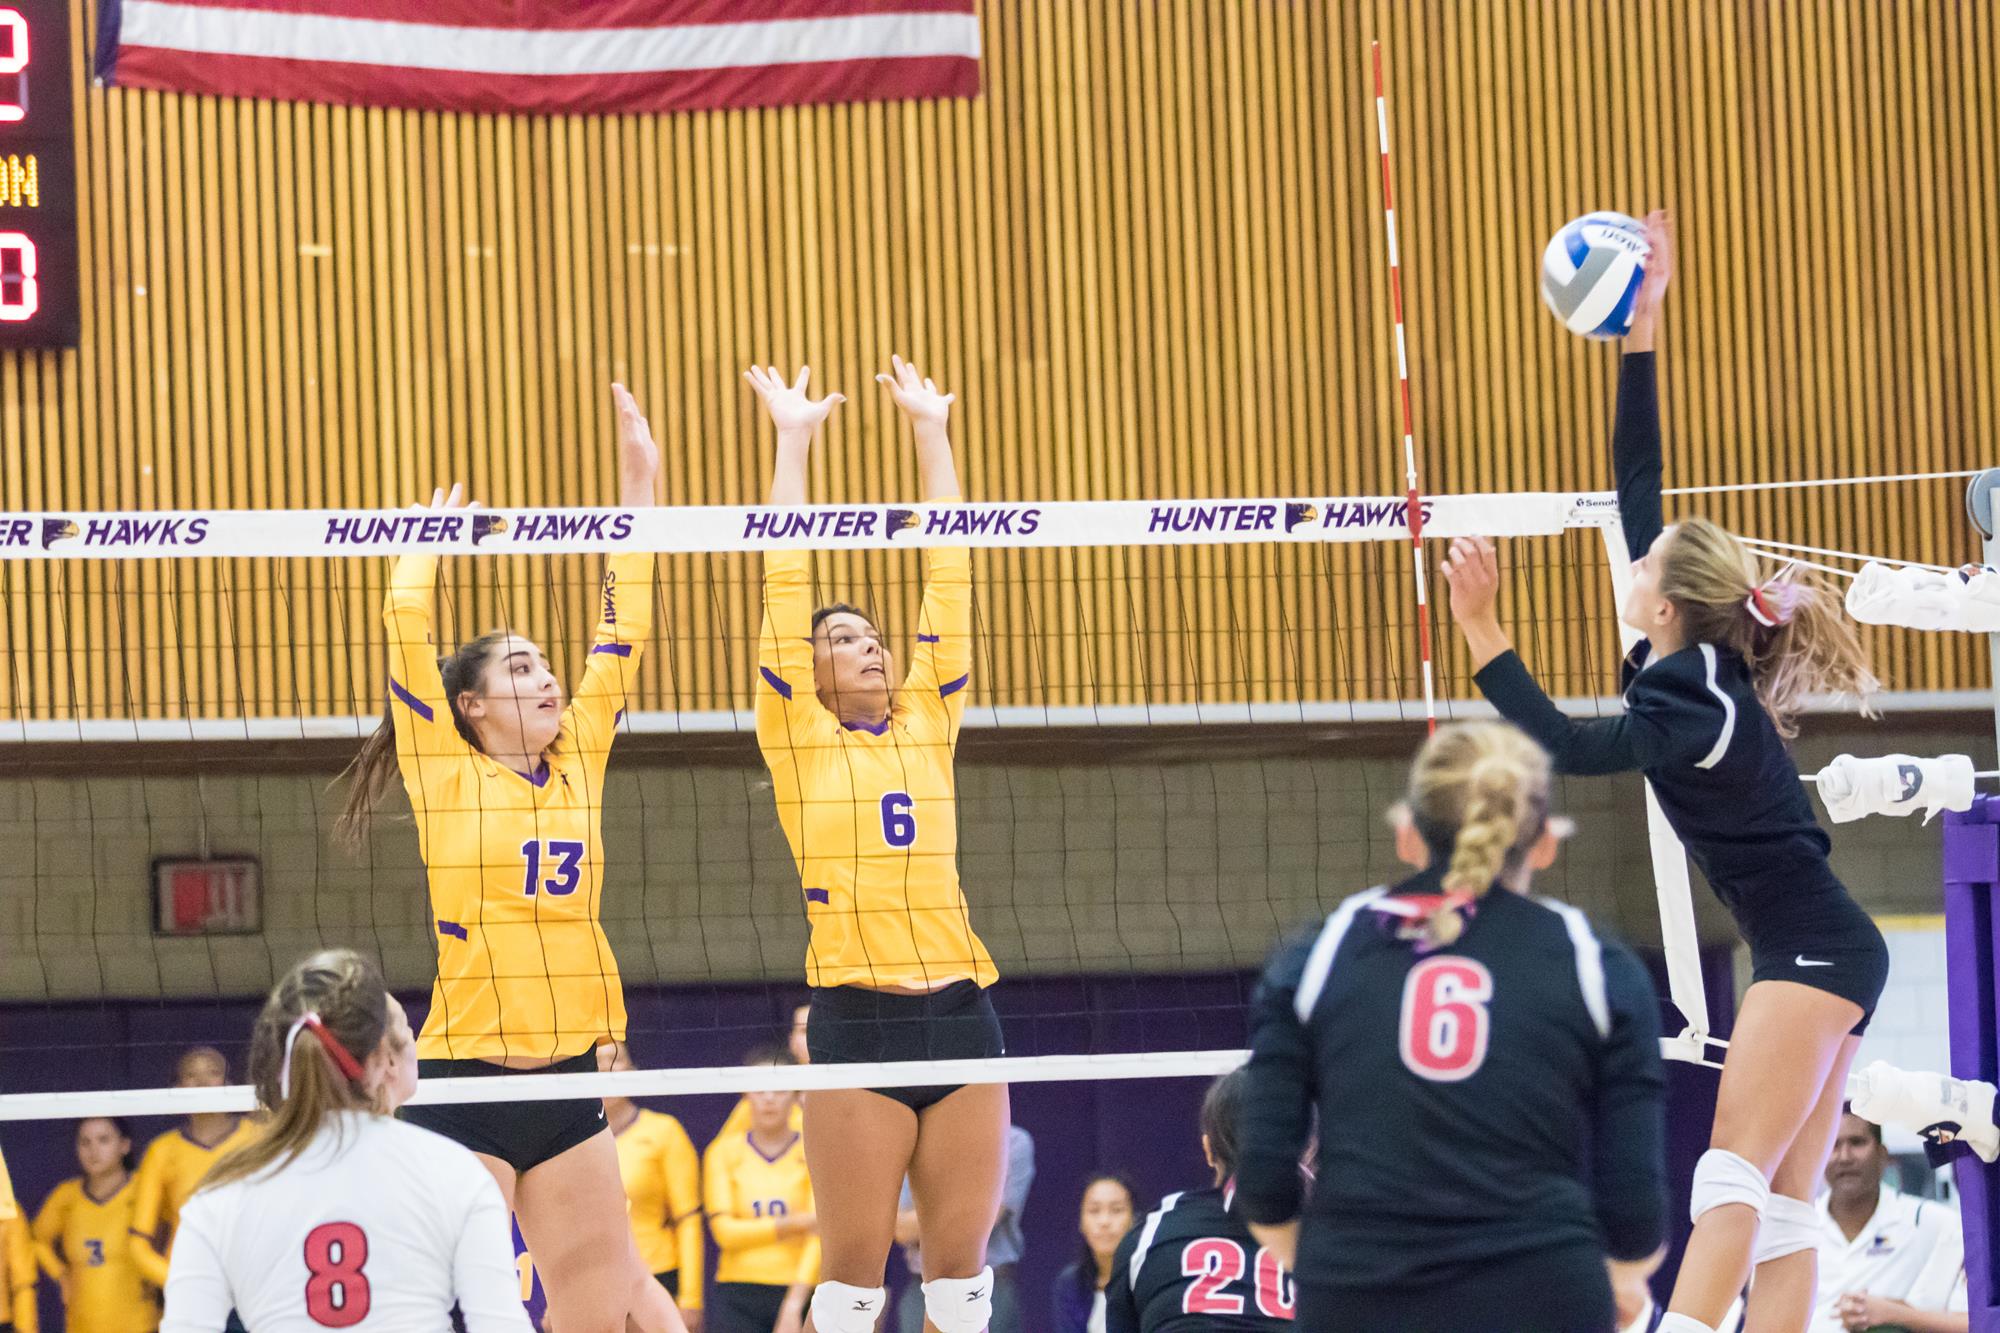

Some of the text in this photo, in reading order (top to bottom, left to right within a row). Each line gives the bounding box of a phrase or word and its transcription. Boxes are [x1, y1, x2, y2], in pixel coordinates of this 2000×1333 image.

[84, 518, 209, 546] HAWKS
[324, 514, 635, 544] HUNTER HAWKS
[743, 509, 1041, 539] HUNTER HAWKS
[1148, 505, 1277, 533] HUNTER
[880, 792, 917, 848] 6
[521, 839, 585, 897] 13
[1399, 955, 1493, 1082] 6
[303, 1220, 371, 1328] 8
[1181, 1236, 1296, 1321] 20
